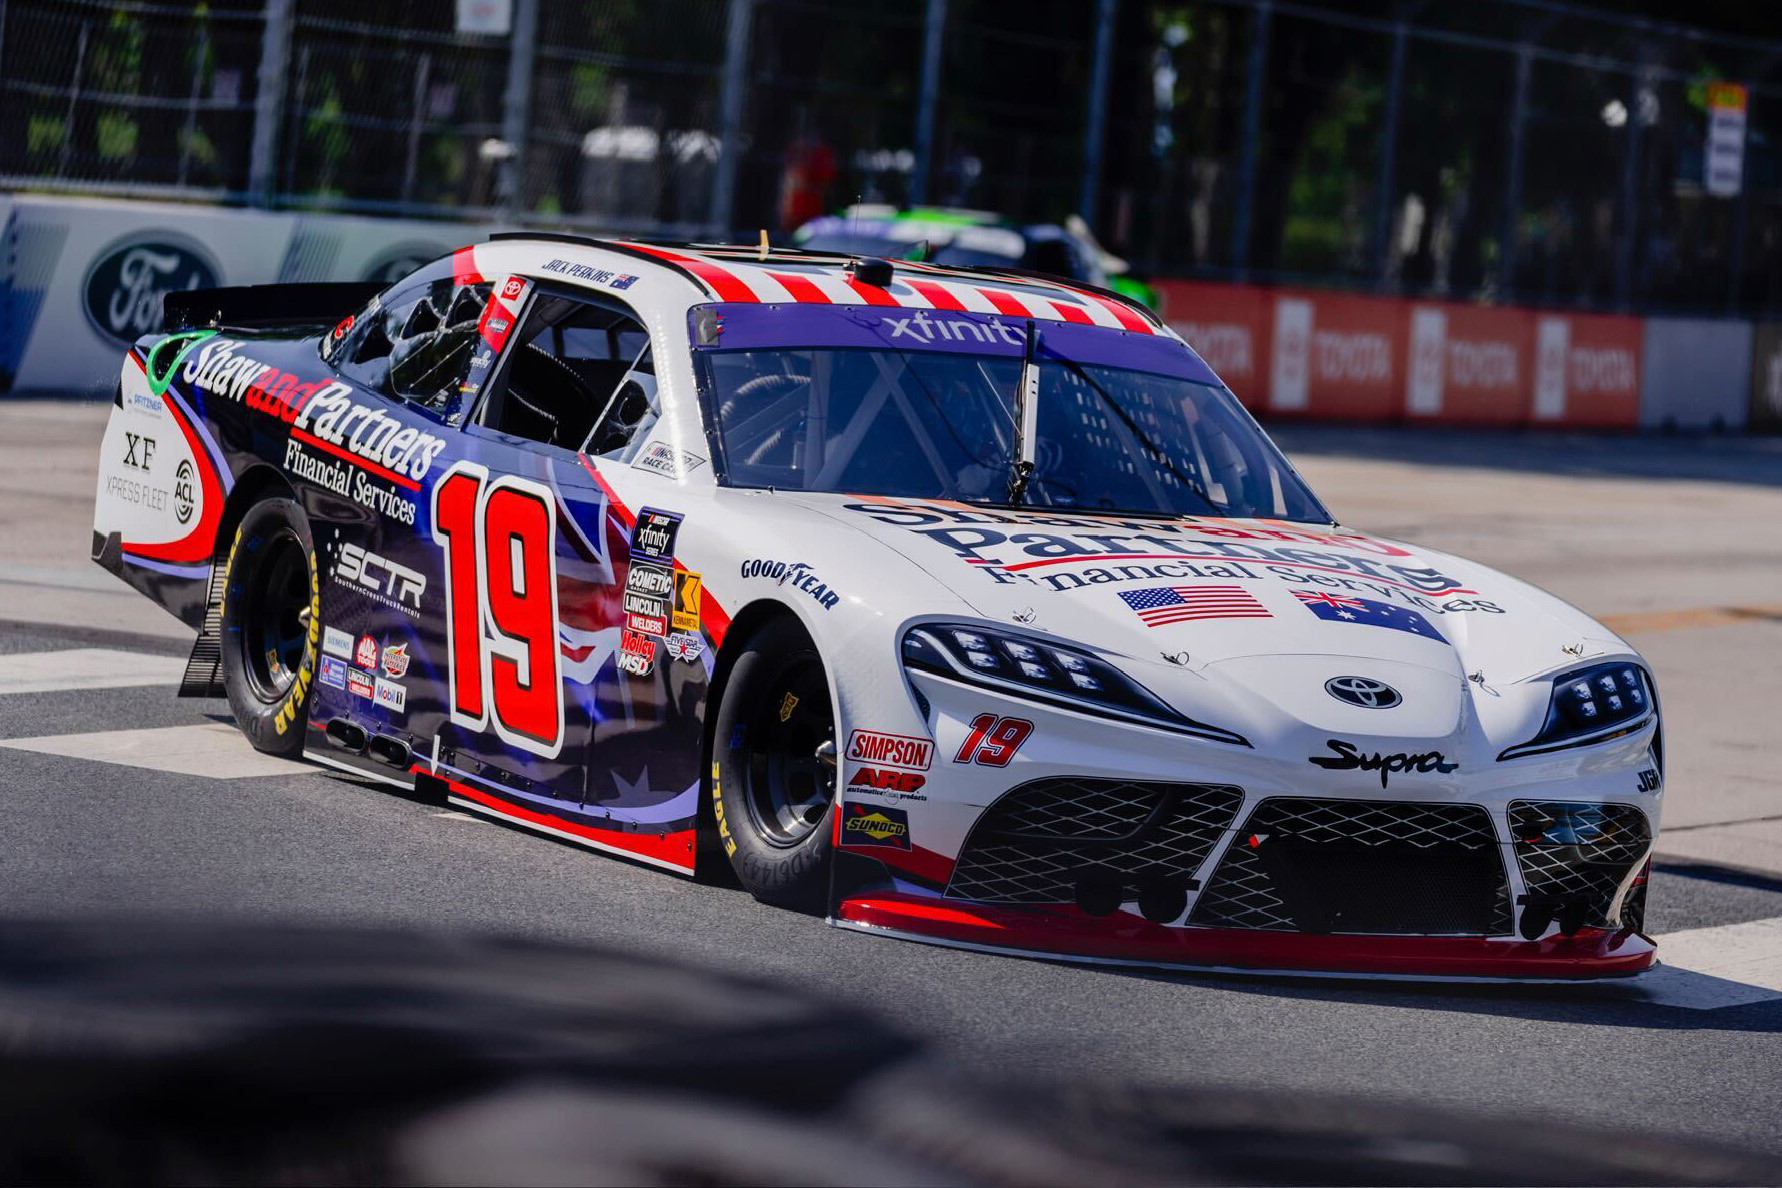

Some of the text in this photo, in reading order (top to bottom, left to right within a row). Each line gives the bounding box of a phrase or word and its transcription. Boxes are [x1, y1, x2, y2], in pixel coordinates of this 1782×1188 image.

[542, 258, 615, 283] JACK PERKINS
[642, 456, 663, 469] RACE
[106, 475, 168, 511] XPRESS FLEET
[174, 481, 194, 504] ACL
[283, 438, 416, 526] Financial Services
[638, 523, 670, 554] xfinity
[909, 526, 1463, 591] Partners
[337, 542, 427, 609] SCTR
[628, 567, 672, 594] COMETIC
[974, 560, 1506, 615] Financial Services
[431, 460, 565, 760] 19
[626, 594, 662, 618] LINCOLN
[631, 615, 663, 634] WELDERS
[621, 630, 656, 662] Holley
[618, 653, 649, 676] MSD
[378, 684, 396, 703] Mobil
[852, 734, 929, 767] SIMPSON
[953, 712, 1035, 768] 19
[1308, 739, 1460, 789] Supra
[848, 767, 927, 793] ARP
[711, 761, 737, 858] EAGLE
[848, 818, 904, 835] SUNOCO
